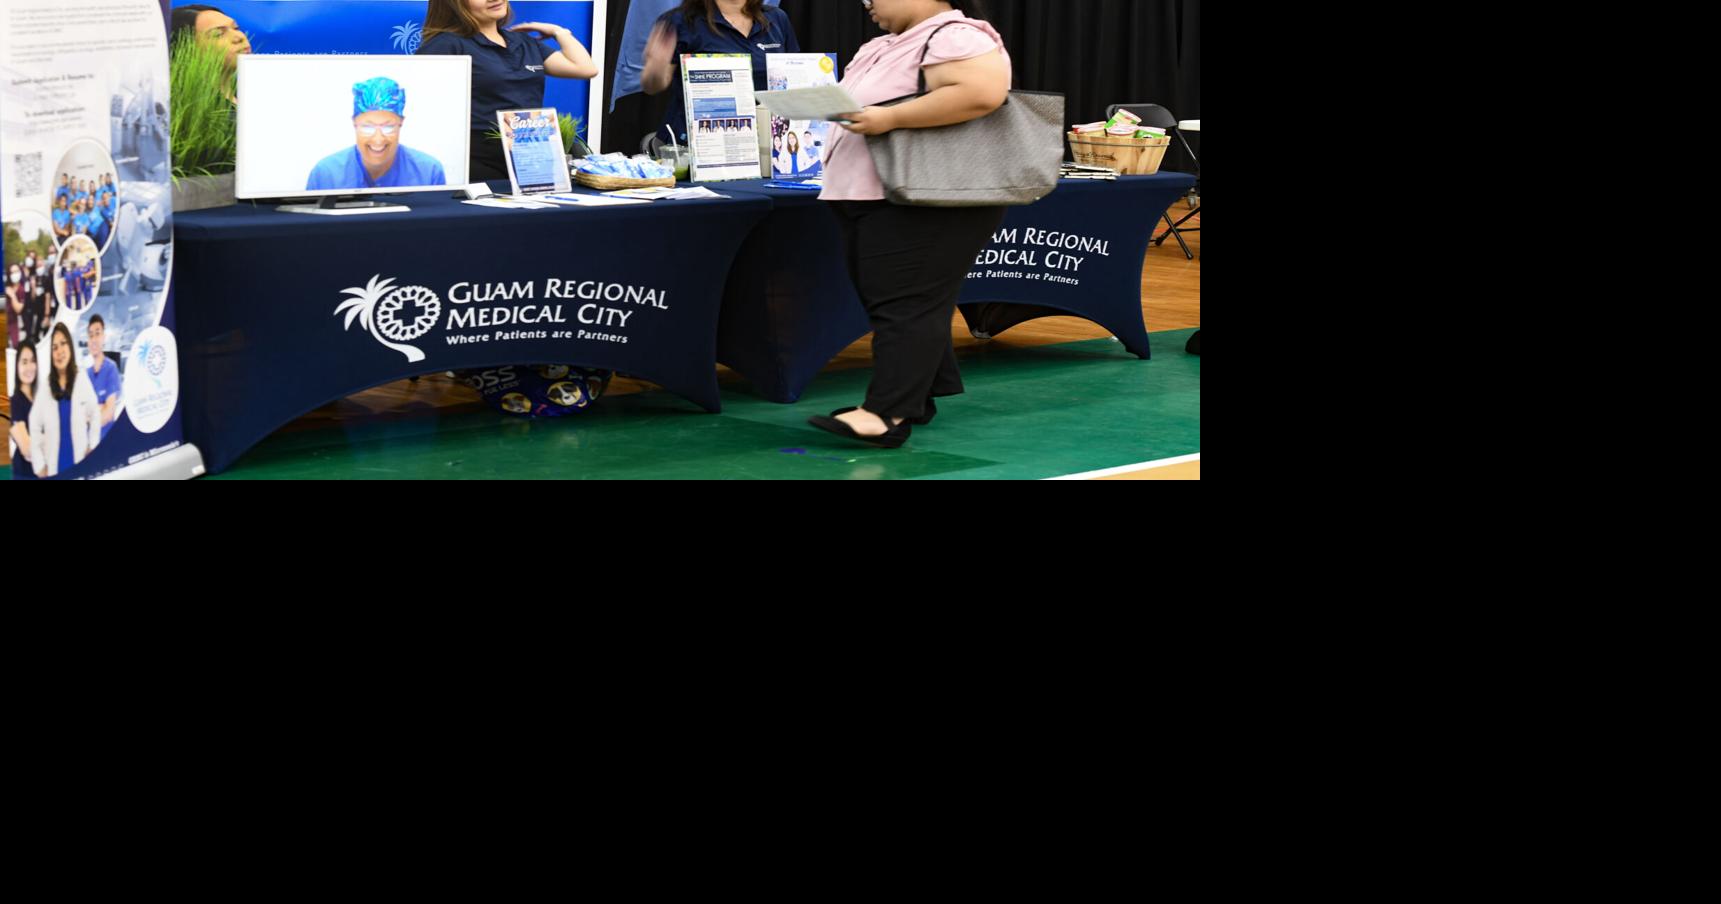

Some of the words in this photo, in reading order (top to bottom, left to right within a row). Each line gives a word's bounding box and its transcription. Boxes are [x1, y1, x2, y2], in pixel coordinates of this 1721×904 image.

[510, 115, 550, 130] Career
[991, 228, 1018, 244] AM
[1023, 227, 1110, 256] REGIONAL
[975, 249, 1037, 266] EDICAL
[1045, 250, 1084, 272] CITY
[965, 271, 983, 279] ere
[986, 269, 1023, 279] Patients
[1025, 272, 1041, 280] are
[1043, 272, 1079, 286] Partners
[448, 280, 534, 304] GUAM
[544, 278, 669, 310] REGIONAL
[445, 305, 566, 330] MEDICAL
[577, 303, 633, 328] CITY
[446, 333, 490, 345] Where
[494, 329, 547, 341] Patients
[552, 330, 572, 339] are
[577, 329, 628, 344] Partners
[465, 366, 517, 390] OSS
